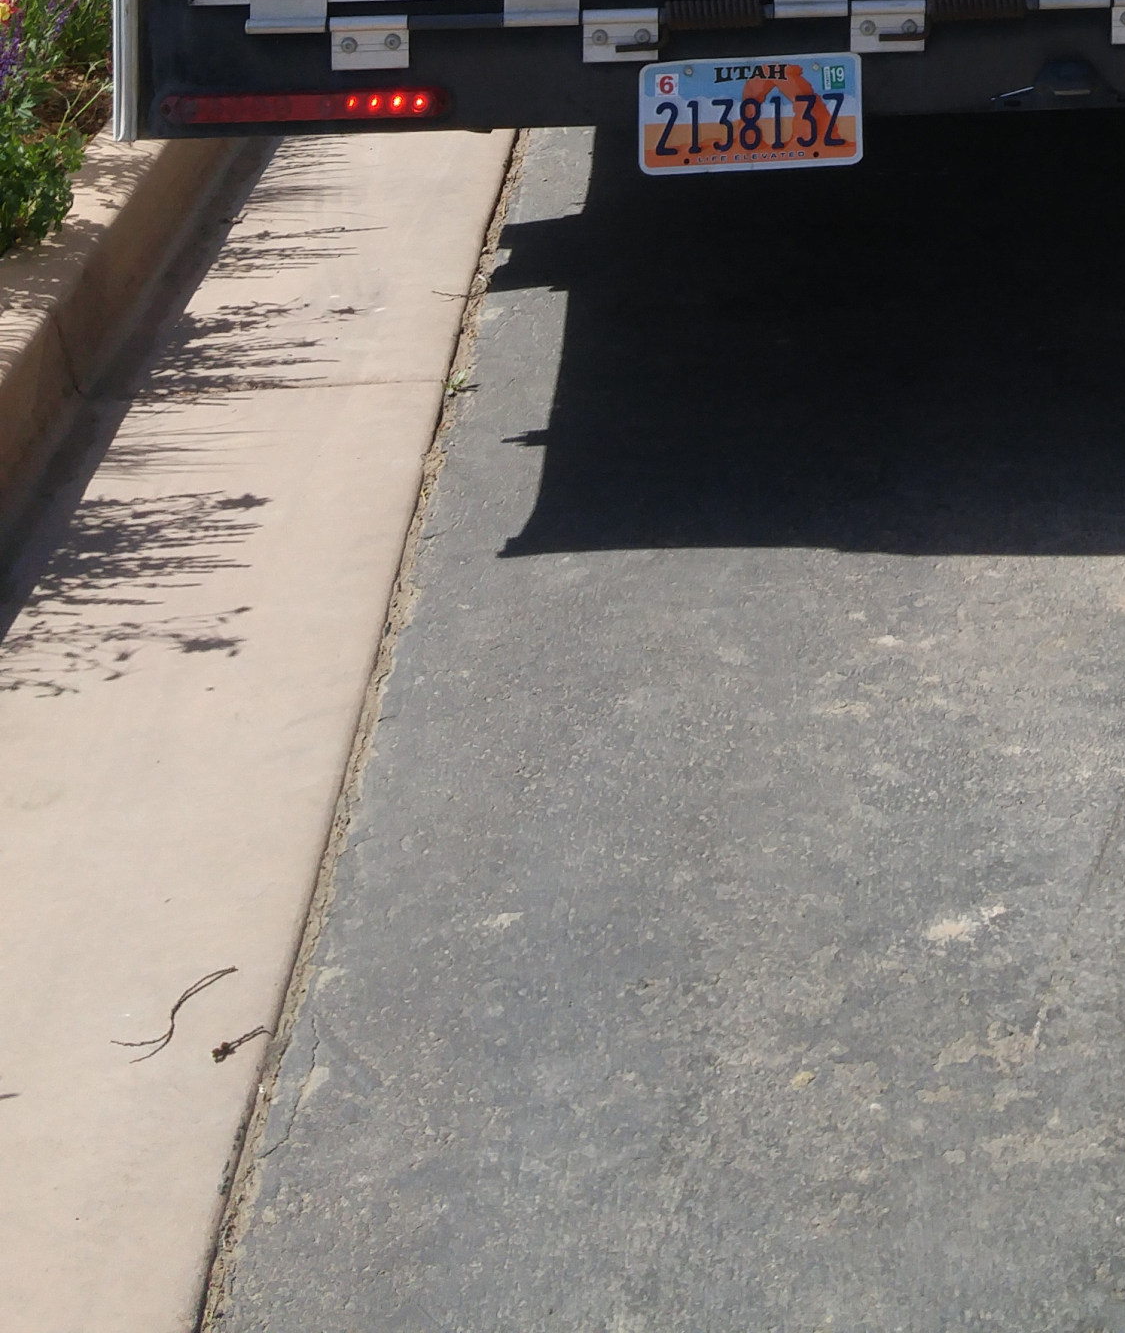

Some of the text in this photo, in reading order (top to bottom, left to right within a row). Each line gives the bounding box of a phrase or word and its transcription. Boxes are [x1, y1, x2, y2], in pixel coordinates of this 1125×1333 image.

[659, 75, 674, 95] 6
[714, 64, 788, 83] UTAH
[830, 67, 845, 83] 19
[655, 93, 846, 156] 213813Z
[698, 150, 806, 164] LIFE ELEVATED
